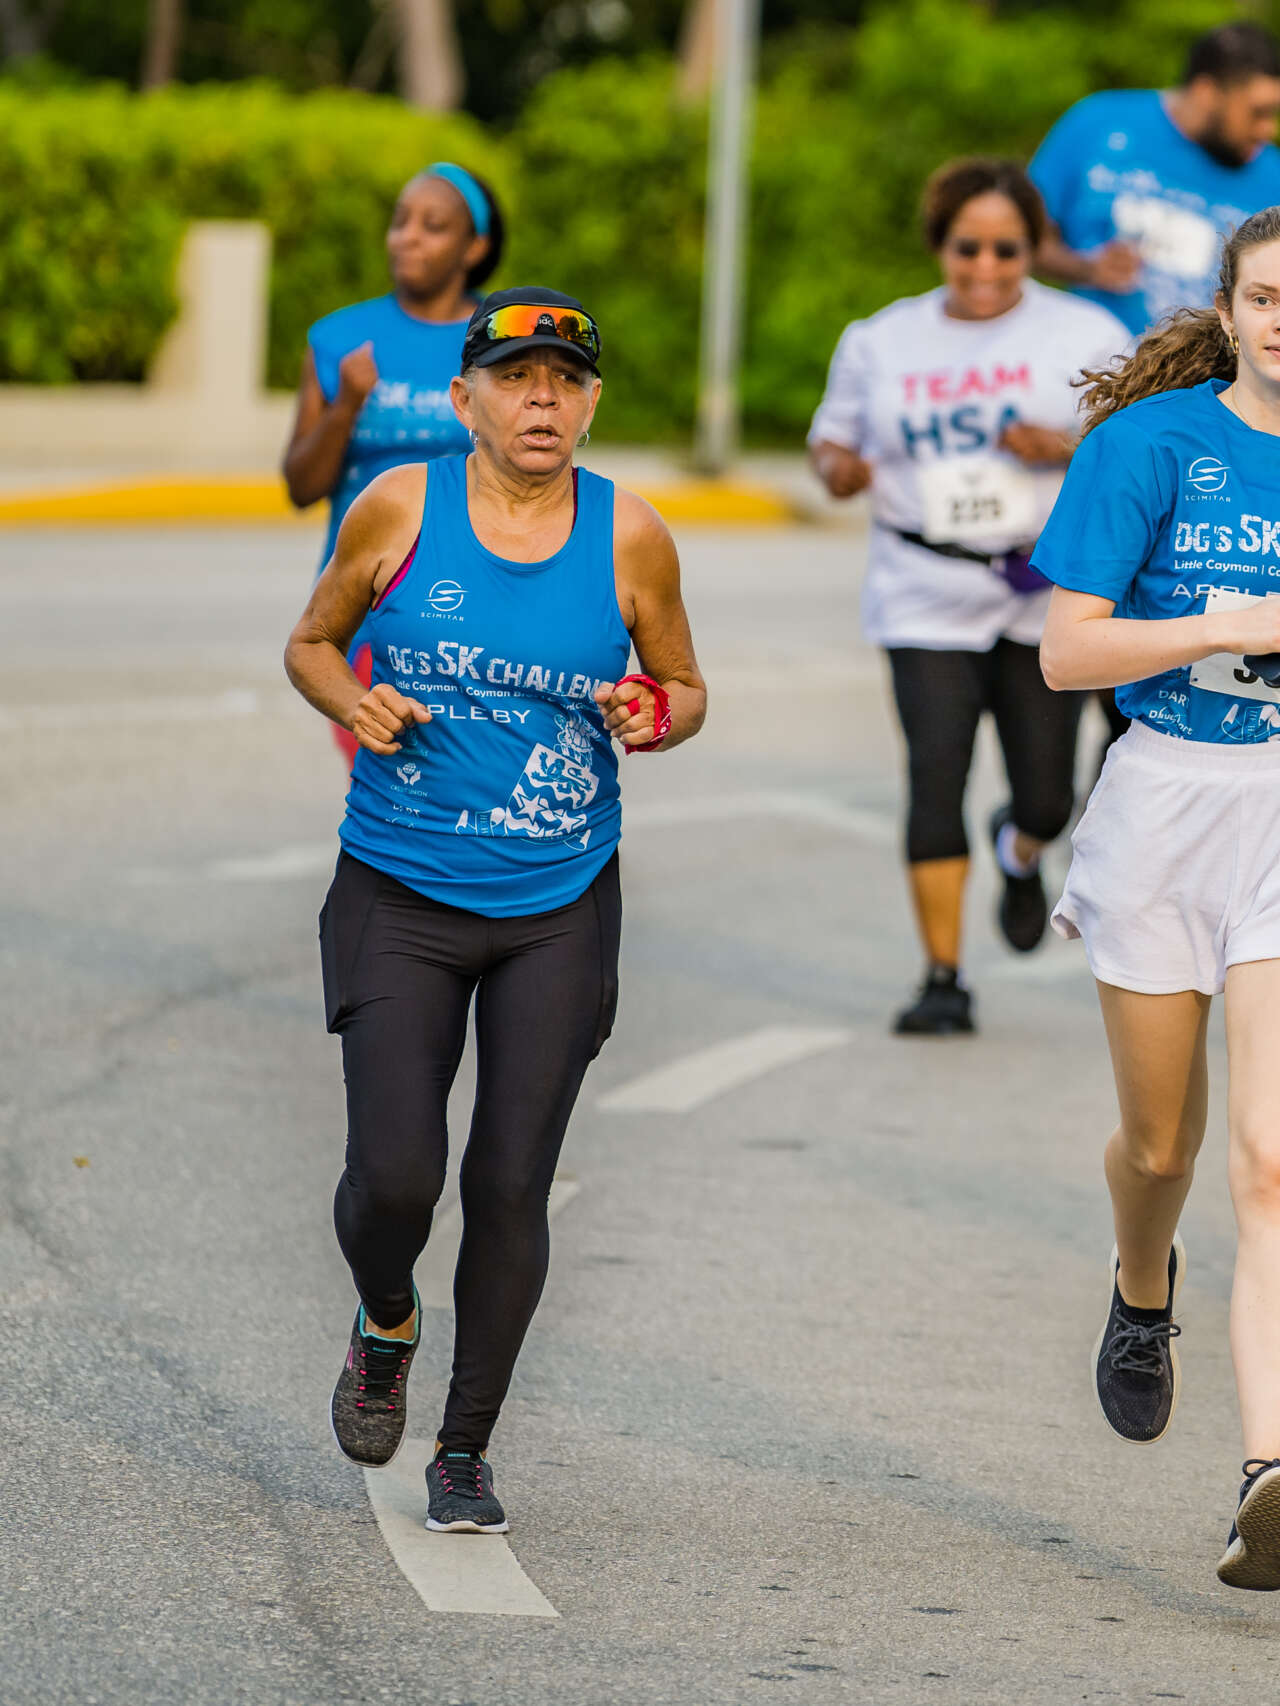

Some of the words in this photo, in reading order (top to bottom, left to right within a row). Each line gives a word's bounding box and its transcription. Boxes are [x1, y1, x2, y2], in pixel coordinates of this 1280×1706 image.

[903, 364, 1031, 404] TEAM
[1174, 559, 1203, 570] Little
[1205, 559, 1258, 574] Cayman
[436, 640, 485, 680] 5K
[486, 658, 602, 701] CHALLEN
[412, 681, 458, 693] Cayman
[466, 686, 511, 698] Cayman
[427, 704, 531, 724] PLEBY
